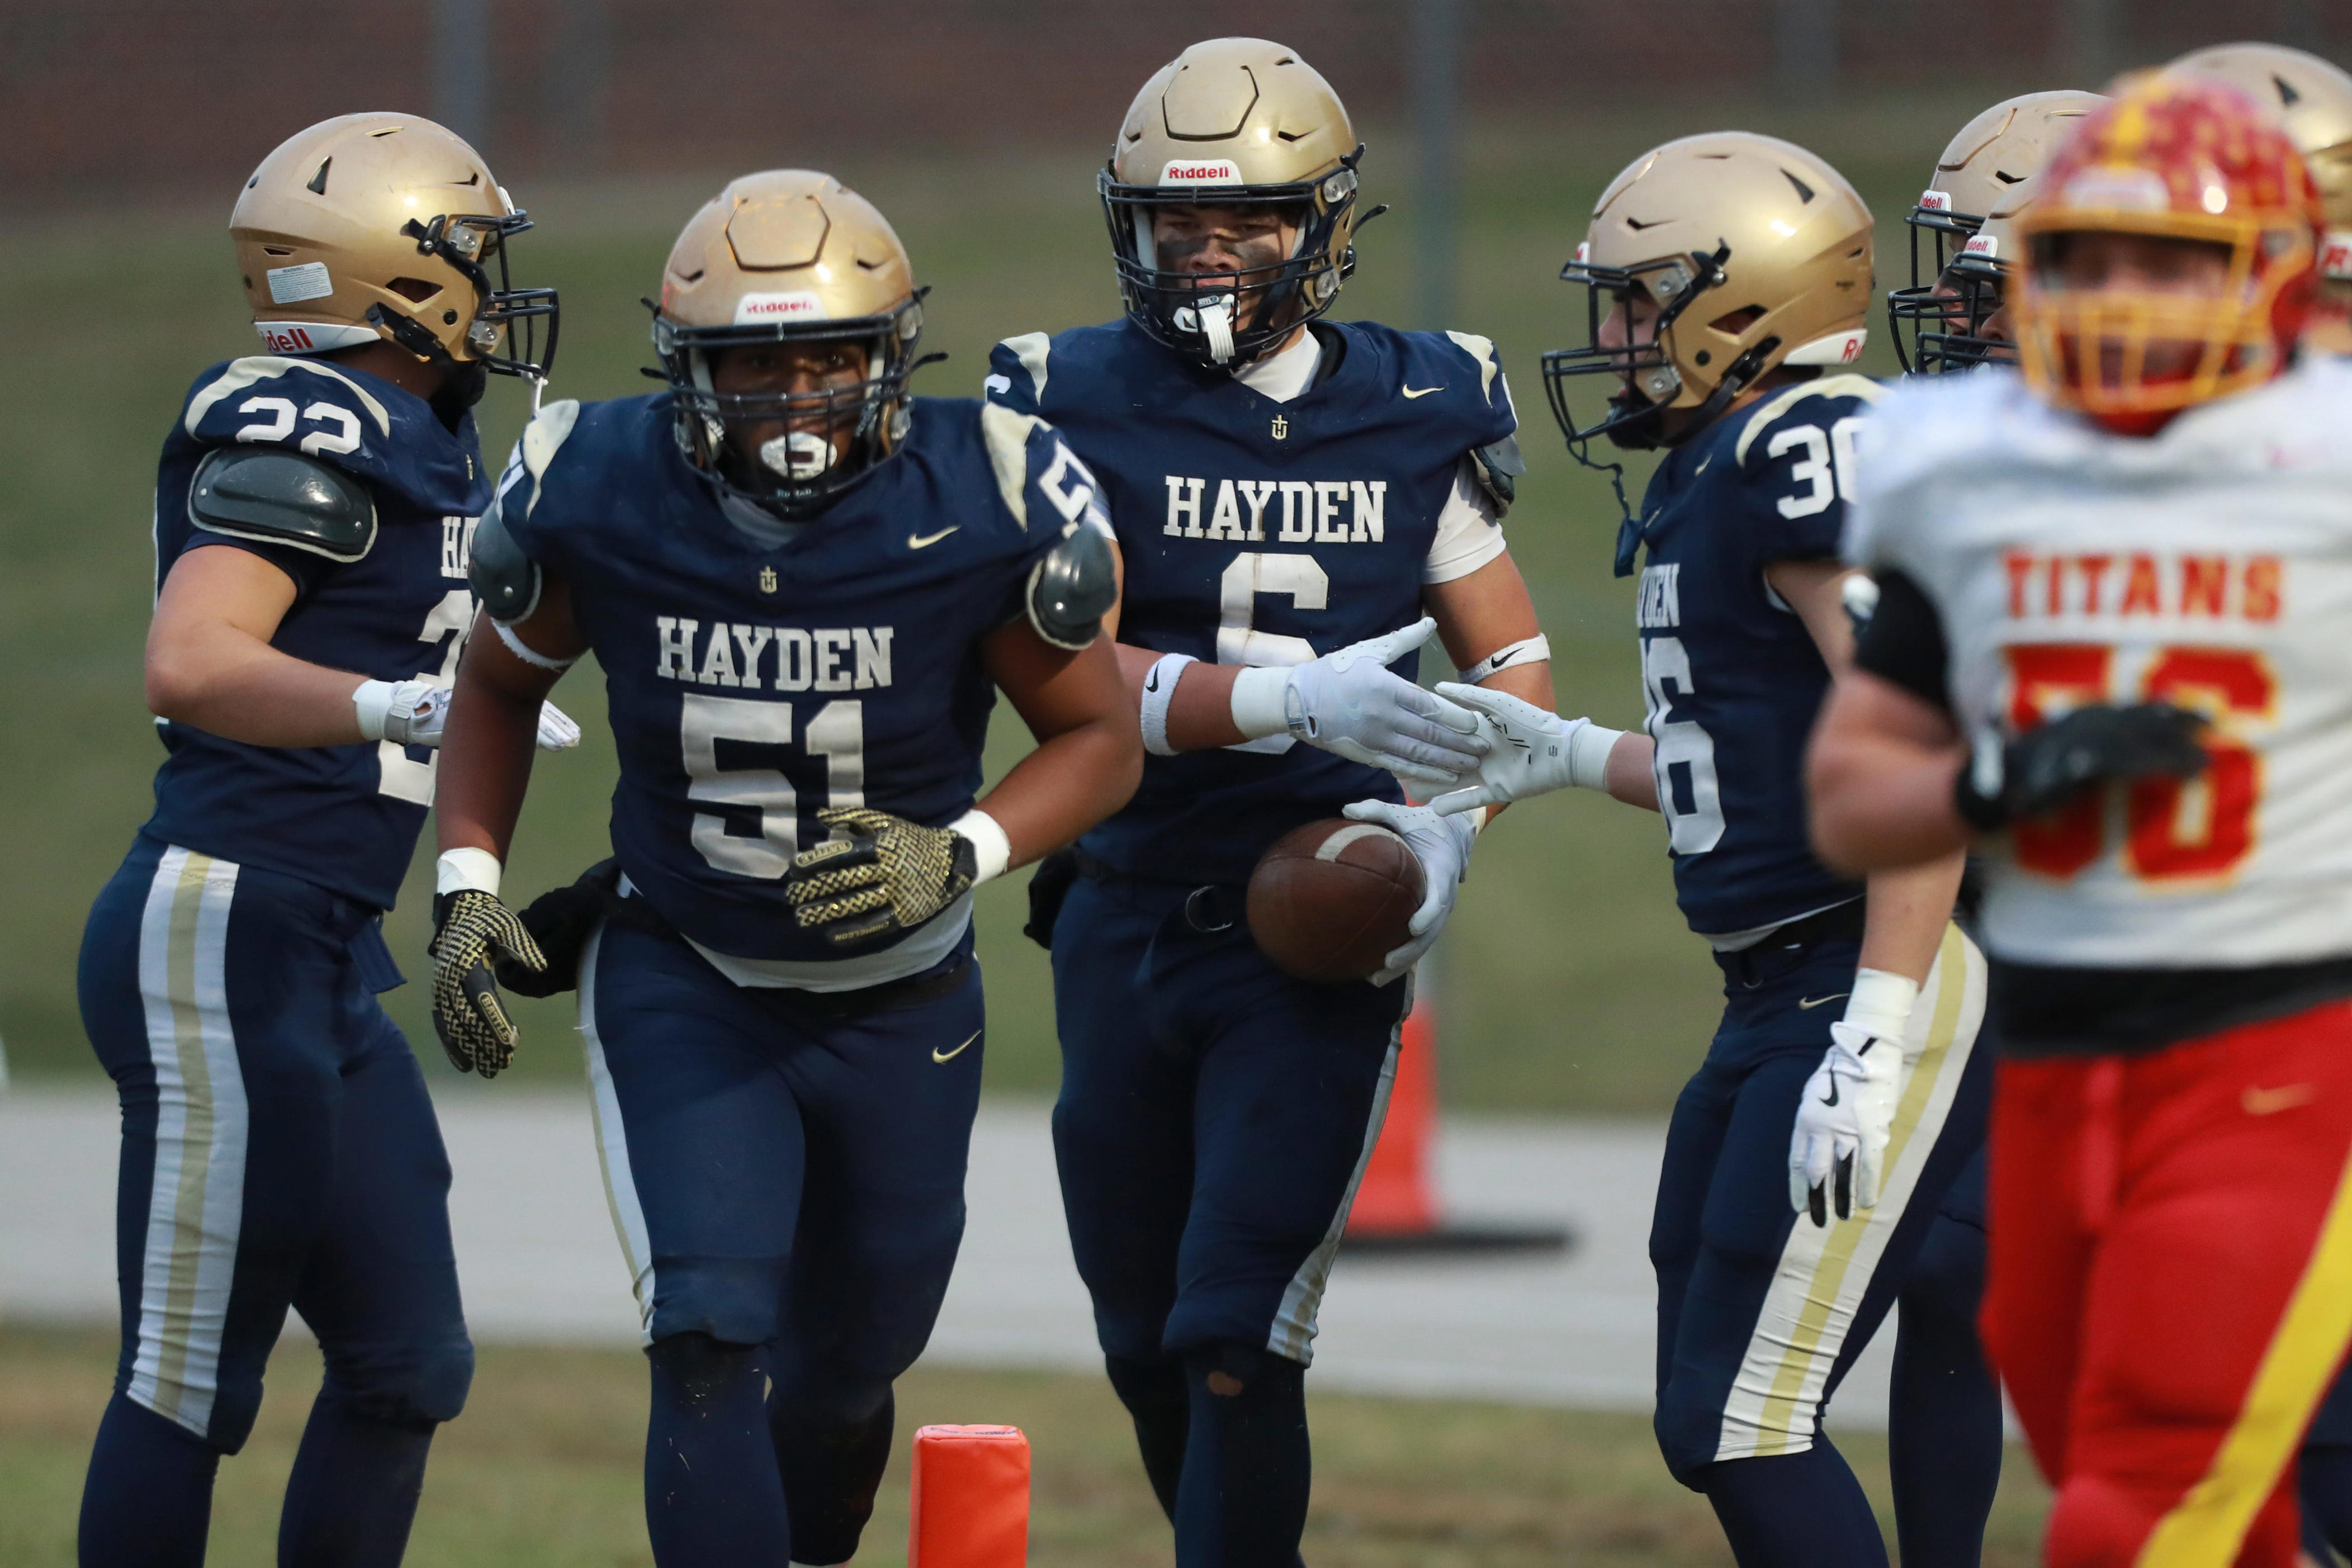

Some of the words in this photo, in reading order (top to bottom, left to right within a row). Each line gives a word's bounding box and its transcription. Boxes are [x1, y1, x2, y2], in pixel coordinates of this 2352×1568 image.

[1168, 167, 1229, 179] Riddell
[261, 328, 314, 352] dell
[235, 396, 361, 457] 22
[1163, 475, 1387, 543] HAYDEN
[2001, 547, 2283, 623] TITANS
[657, 615, 894, 692] HAYDEN
[1217, 552, 1329, 755] 6
[378, 590, 484, 807] 2
[682, 692, 863, 879] 51
